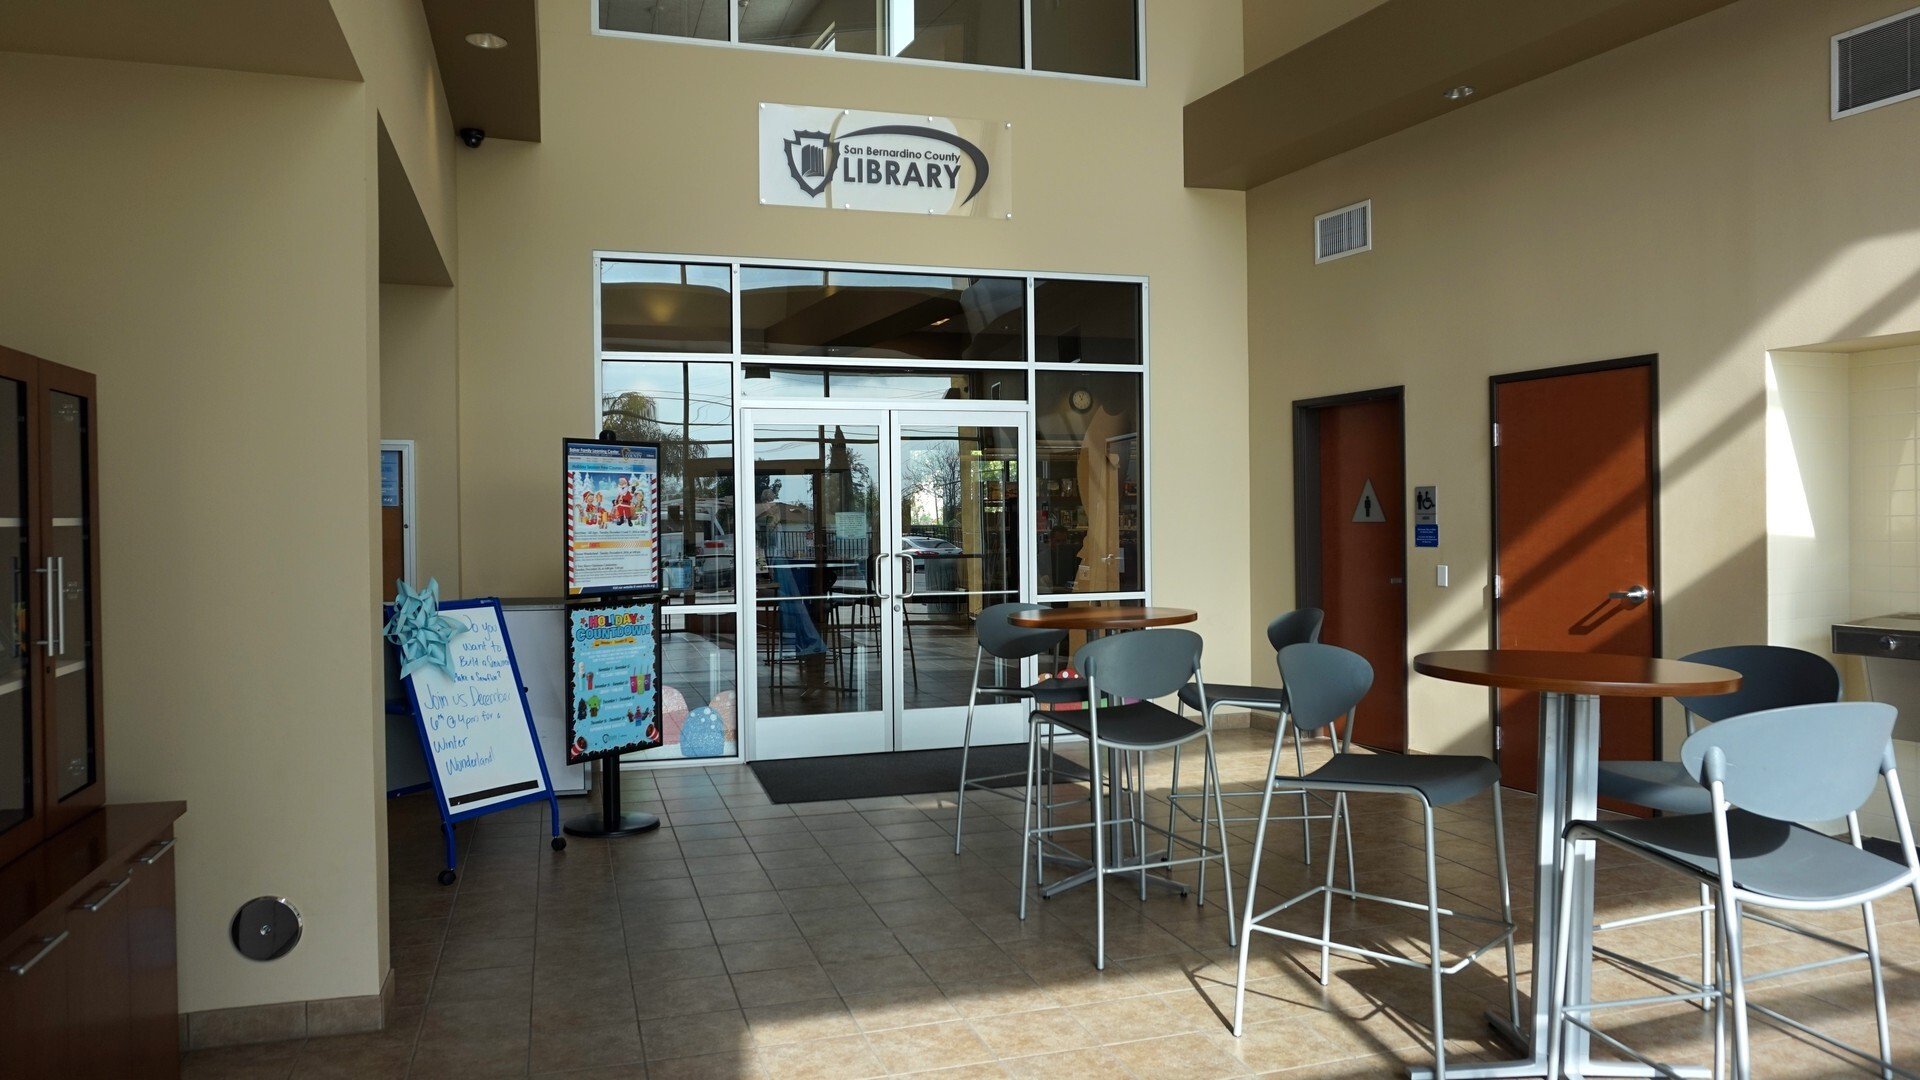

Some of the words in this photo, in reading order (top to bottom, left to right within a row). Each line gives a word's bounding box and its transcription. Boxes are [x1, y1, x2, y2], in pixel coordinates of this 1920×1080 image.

[844, 145, 863, 155] San
[866, 146, 922, 159] Bernardino
[924, 151, 960, 164] County
[843, 157, 961, 189] LIBRARY
[588, 612, 638, 629] HOLIDAY
[482, 622, 497, 642] you
[576, 624, 651, 642] COUNTDOWN
[463, 641, 487, 652] want
[491, 641, 502, 653] to
[424, 684, 448, 710] Join
[452, 693, 468, 708] us
[469, 686, 511, 707] December
[446, 715, 456, 729] @
[481, 711, 493, 721] for
[433, 735, 468, 754] Winter
